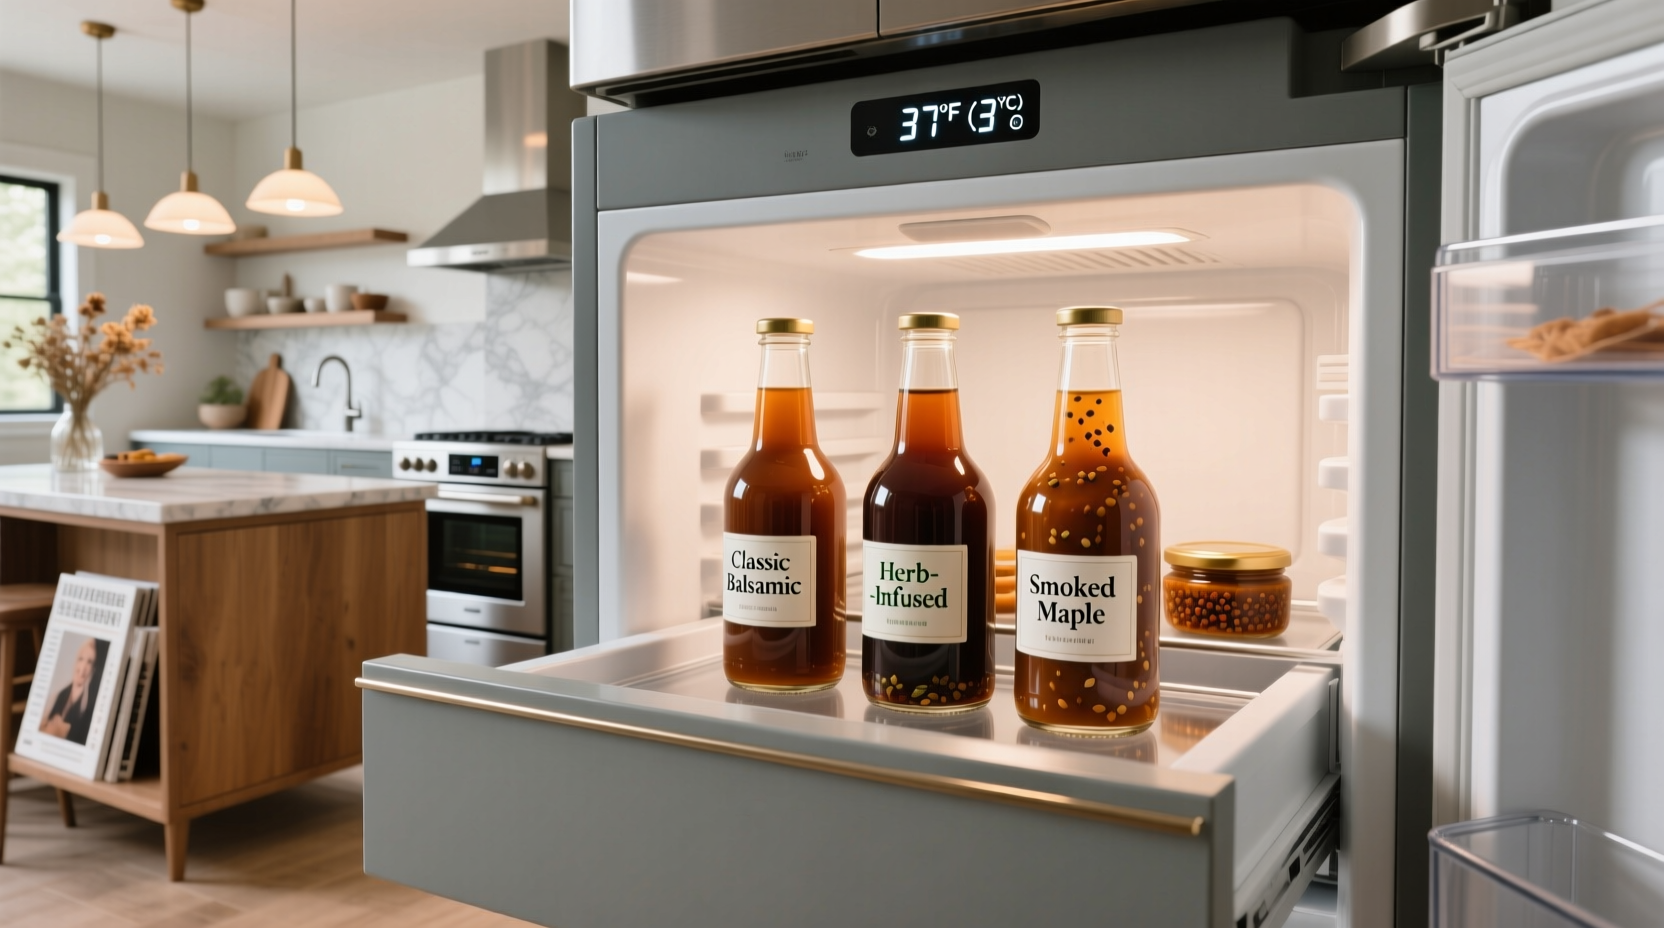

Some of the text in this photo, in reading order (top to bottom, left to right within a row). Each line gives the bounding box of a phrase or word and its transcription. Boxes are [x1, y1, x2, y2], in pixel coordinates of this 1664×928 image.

[731, 549, 791, 571] Classic
[727, 572, 802, 595] Balsamic
[880, 561, 939, 583] Herb-
[869, 585, 948, 609] -Infused
[1030, 573, 1116, 598] Smoked
[1037, 600, 1106, 631] Maple
